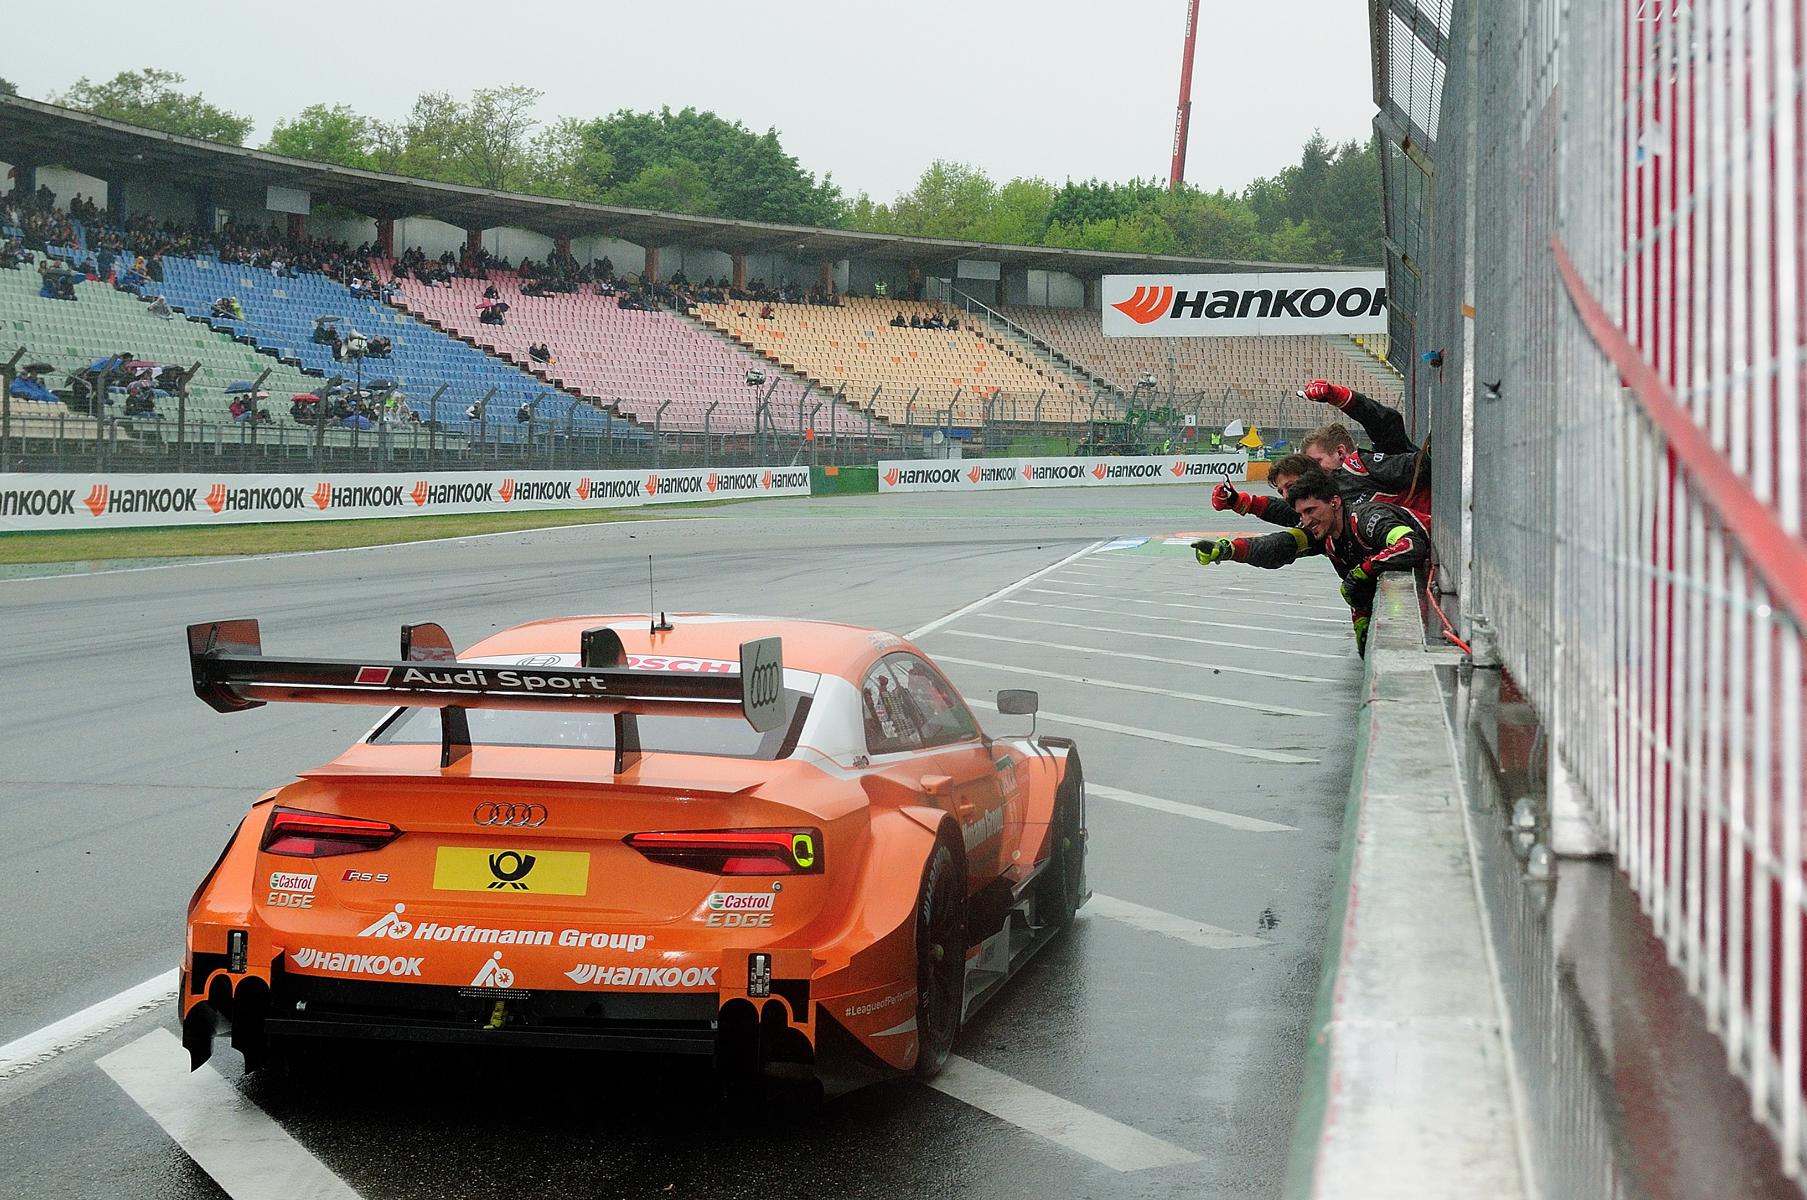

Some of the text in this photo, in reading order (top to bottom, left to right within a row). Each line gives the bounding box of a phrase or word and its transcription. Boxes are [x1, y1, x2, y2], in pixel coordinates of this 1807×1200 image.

[402, 669, 607, 691] Audi Sport
[279, 875, 313, 890] Castrol
[348, 871, 389, 883] RS 5
[266, 891, 316, 909] EDGE
[725, 895, 770, 908] Castrol
[705, 912, 775, 928] EDGE
[413, 922, 647, 953] Hoffmann Group
